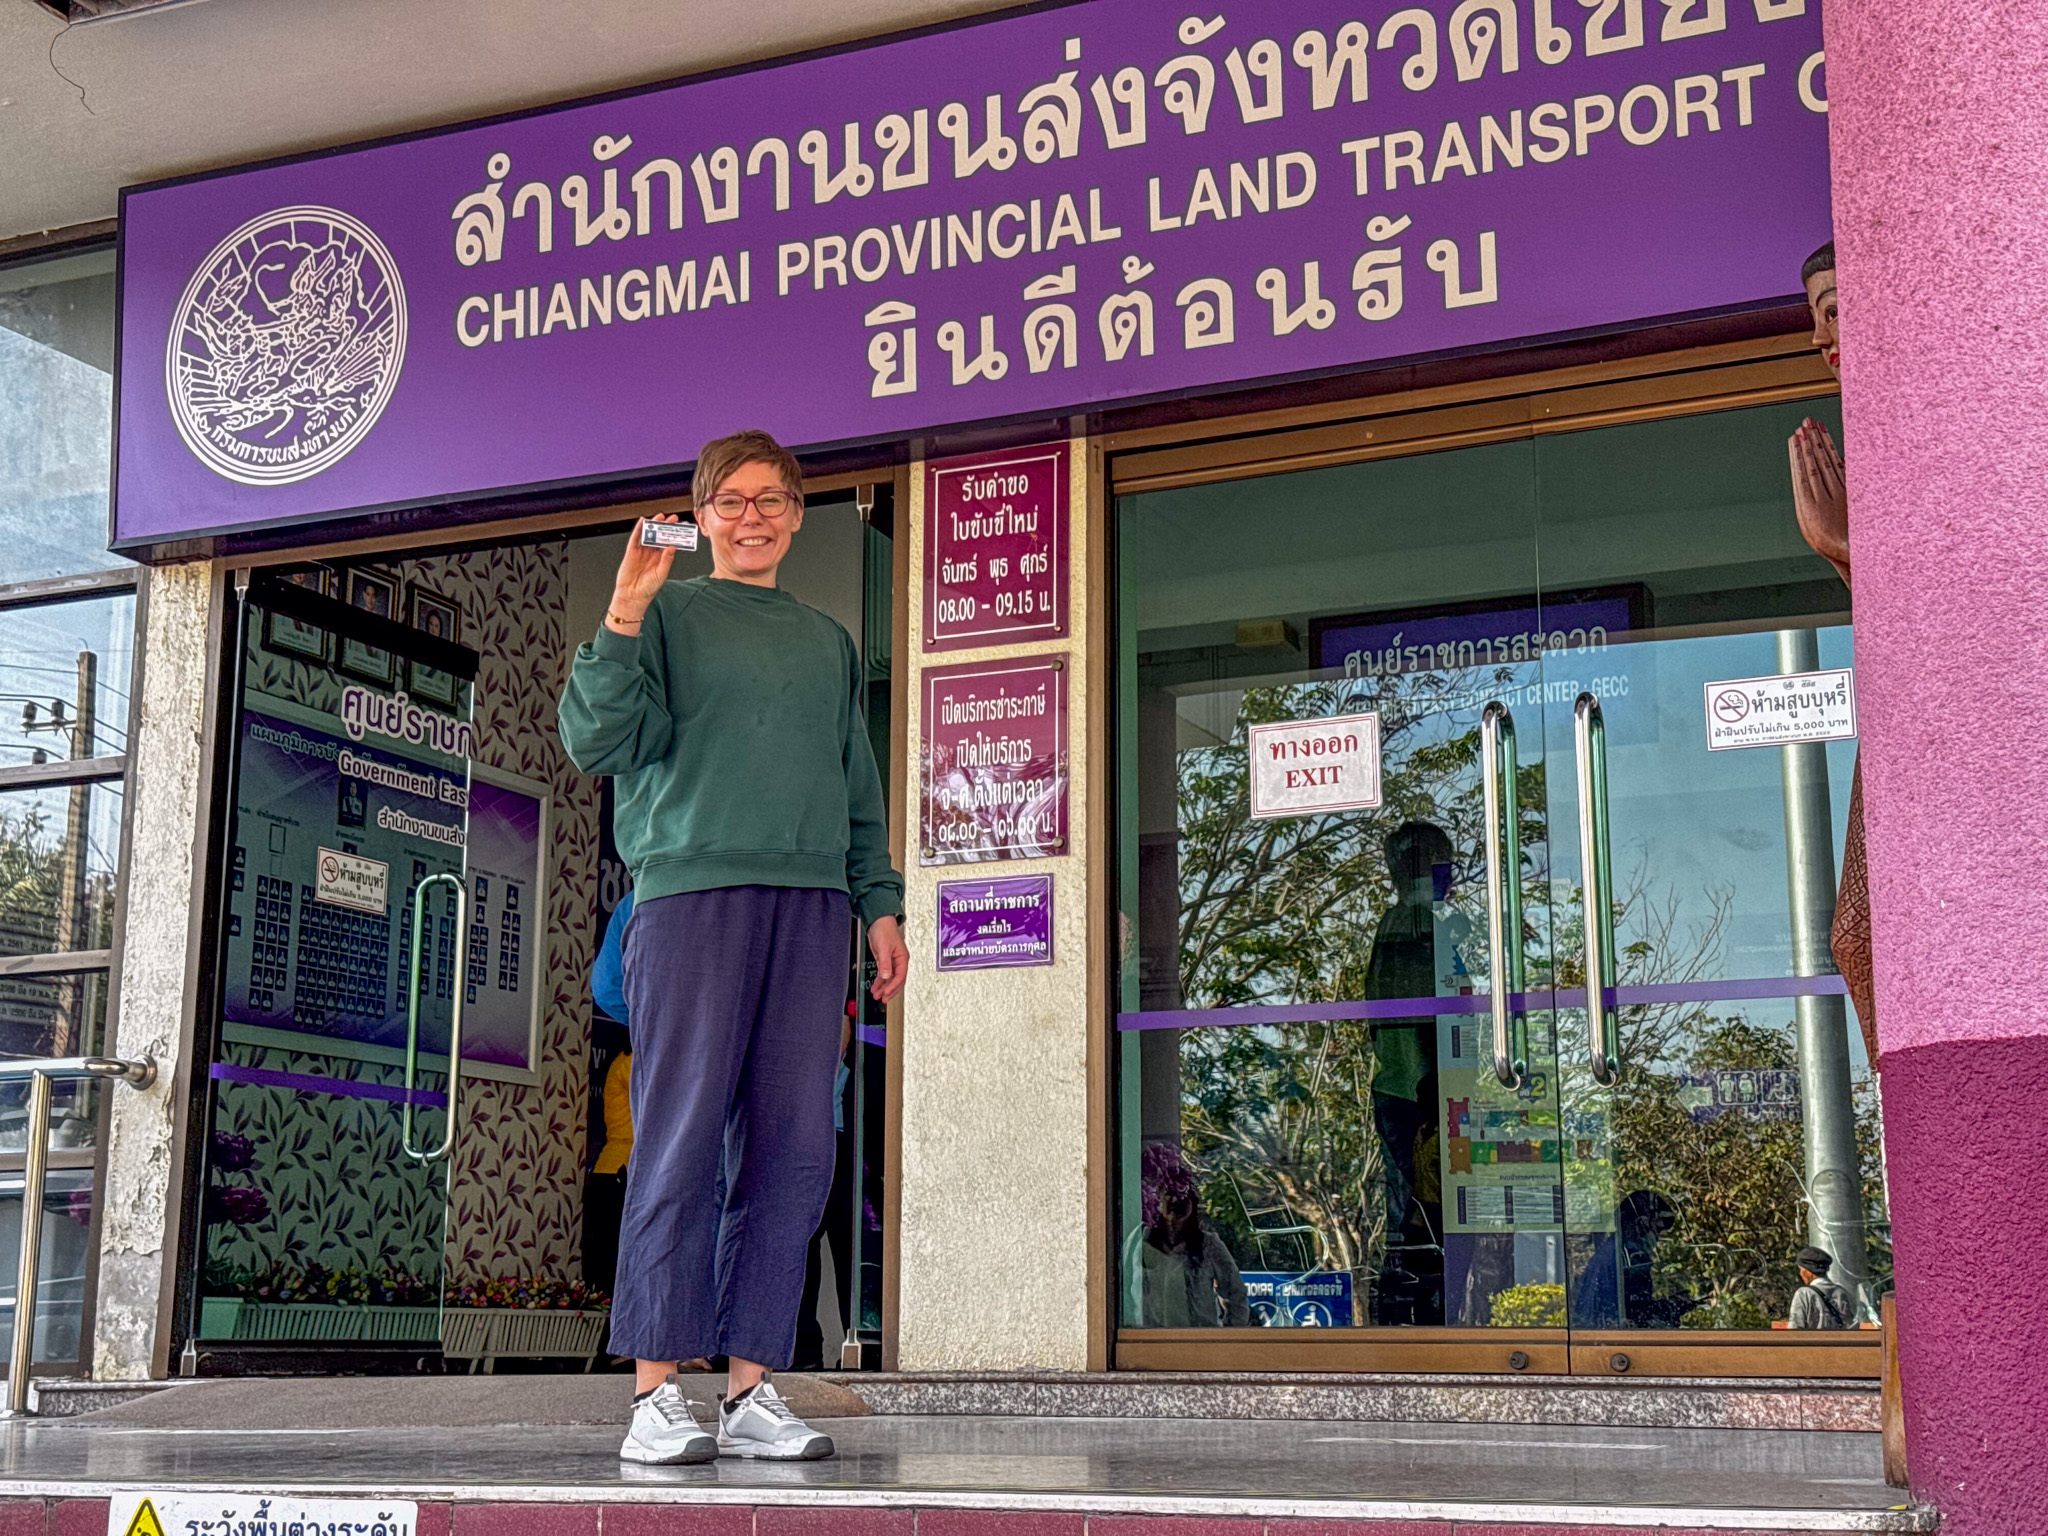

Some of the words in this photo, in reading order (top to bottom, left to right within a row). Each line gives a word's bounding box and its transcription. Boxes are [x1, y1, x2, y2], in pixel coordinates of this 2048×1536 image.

[456, 251, 750, 348] CHIANGMAI
[777, 188, 1122, 297] PROVINCIAL
[1147, 150, 1318, 233] LAND
[1341, 62, 1766, 197] TRANSPORT
[864, 214, 1499, 398] ยินดีต้อนรับ
[962, 471, 1029, 502] รับคำขอ
[950, 503, 1039, 542] ใบขับขี่ใหม่
[941, 553, 978, 584] จันทร์
[989, 556, 1009, 586] พุธ
[1020, 544, 1049, 582] ศุกร์
[938, 596, 976, 624] 08.00
[995, 589, 1034, 617] 09.15
[941, 683, 1046, 725] เปิดบริการชำระภาษี
[1526, 679, 1579, 706] CENTER
[1592, 674, 1629, 699] GECC
[1751, 676, 1847, 719] ห้ามสูบบุหรี่
[1793, 720, 1825, 732] 5,000
[1828, 719, 1849, 728] บาท
[956, 731, 1032, 768] เปิดให้บริการ
[1268, 733, 1358, 761] ทางออก
[339, 750, 436, 798] Government
[1285, 765, 1344, 789] EXIT
[377, 805, 466, 847] สำนักงานขนส่ง
[339, 861, 385, 894] ห้ามสูบบุหรี่
[948, 885, 1040, 914] สถานที่ราชการ
[976, 916, 1012, 935] งดเรี่ยไร
